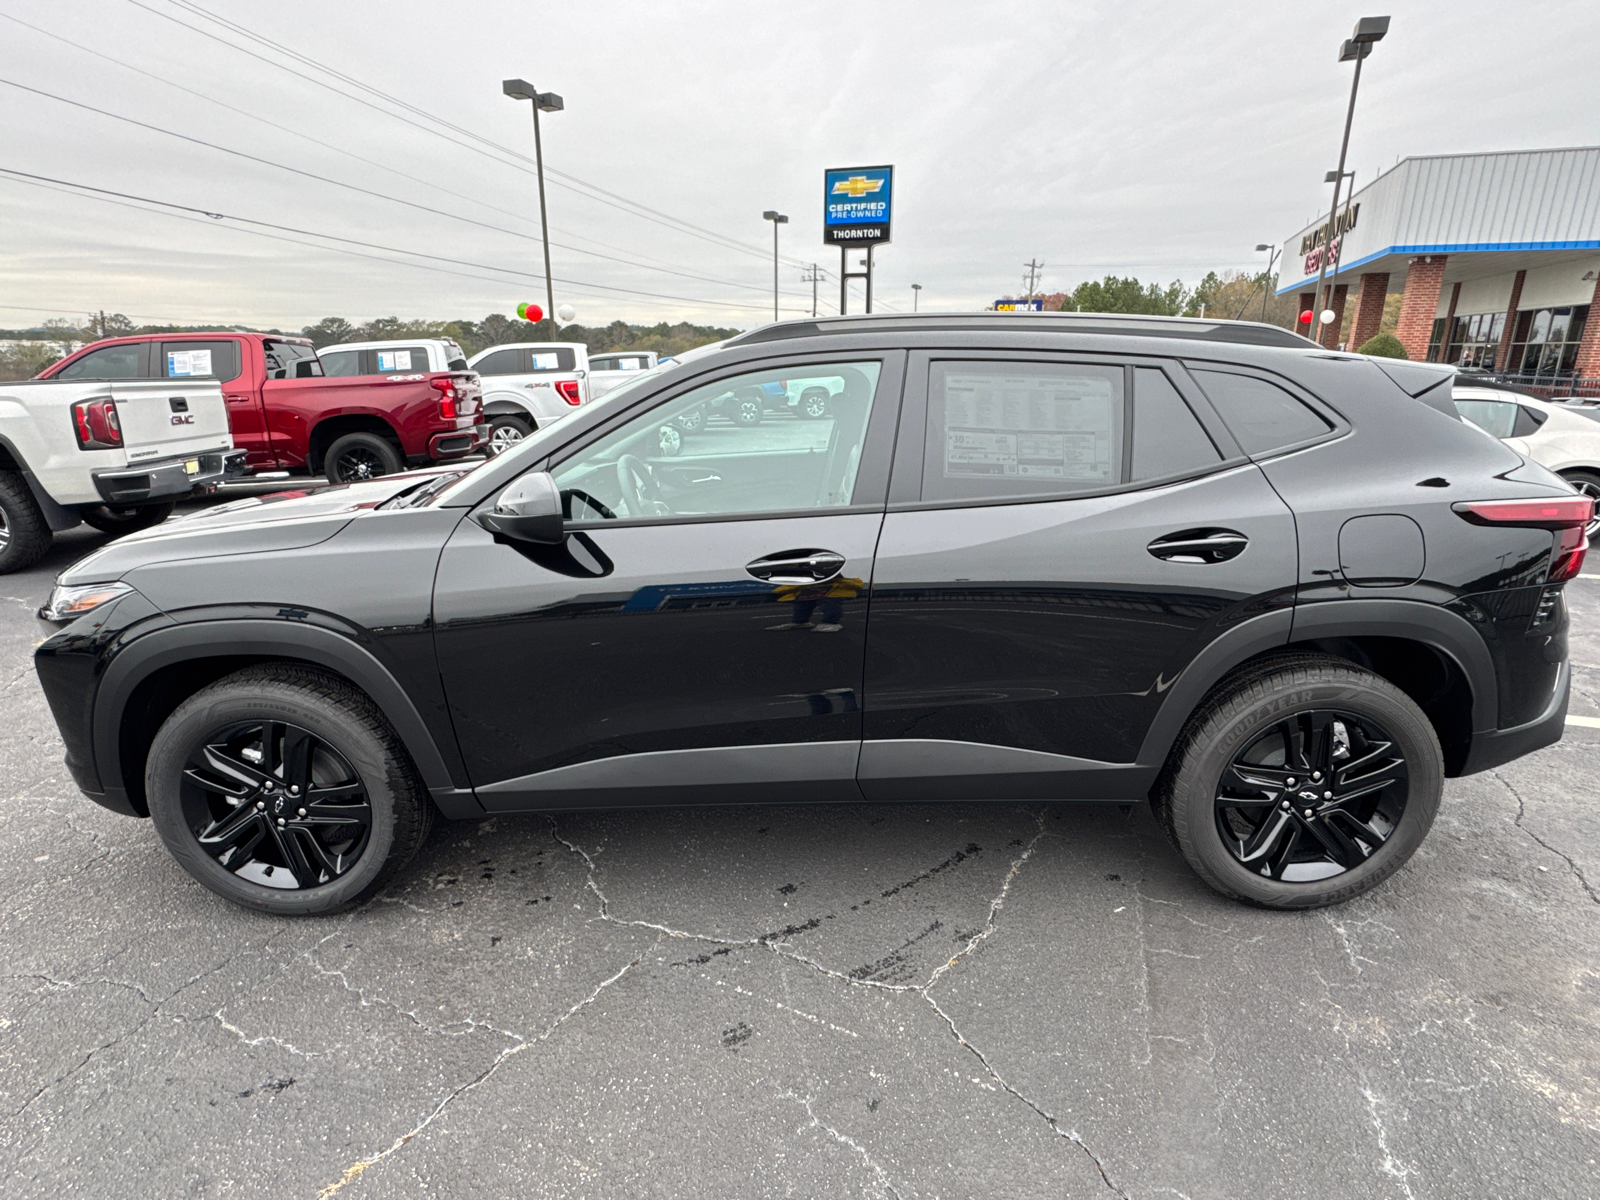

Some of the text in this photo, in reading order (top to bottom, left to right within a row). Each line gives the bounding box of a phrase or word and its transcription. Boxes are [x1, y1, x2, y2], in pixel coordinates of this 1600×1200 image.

[829, 202, 886, 212] CERTIFIED
[831, 210, 883, 219] PRE-OWNED
[833, 228, 881, 239] THORNTON
[171, 415, 195, 426] GMC
[1217, 690, 1314, 754] GOODYEAR
